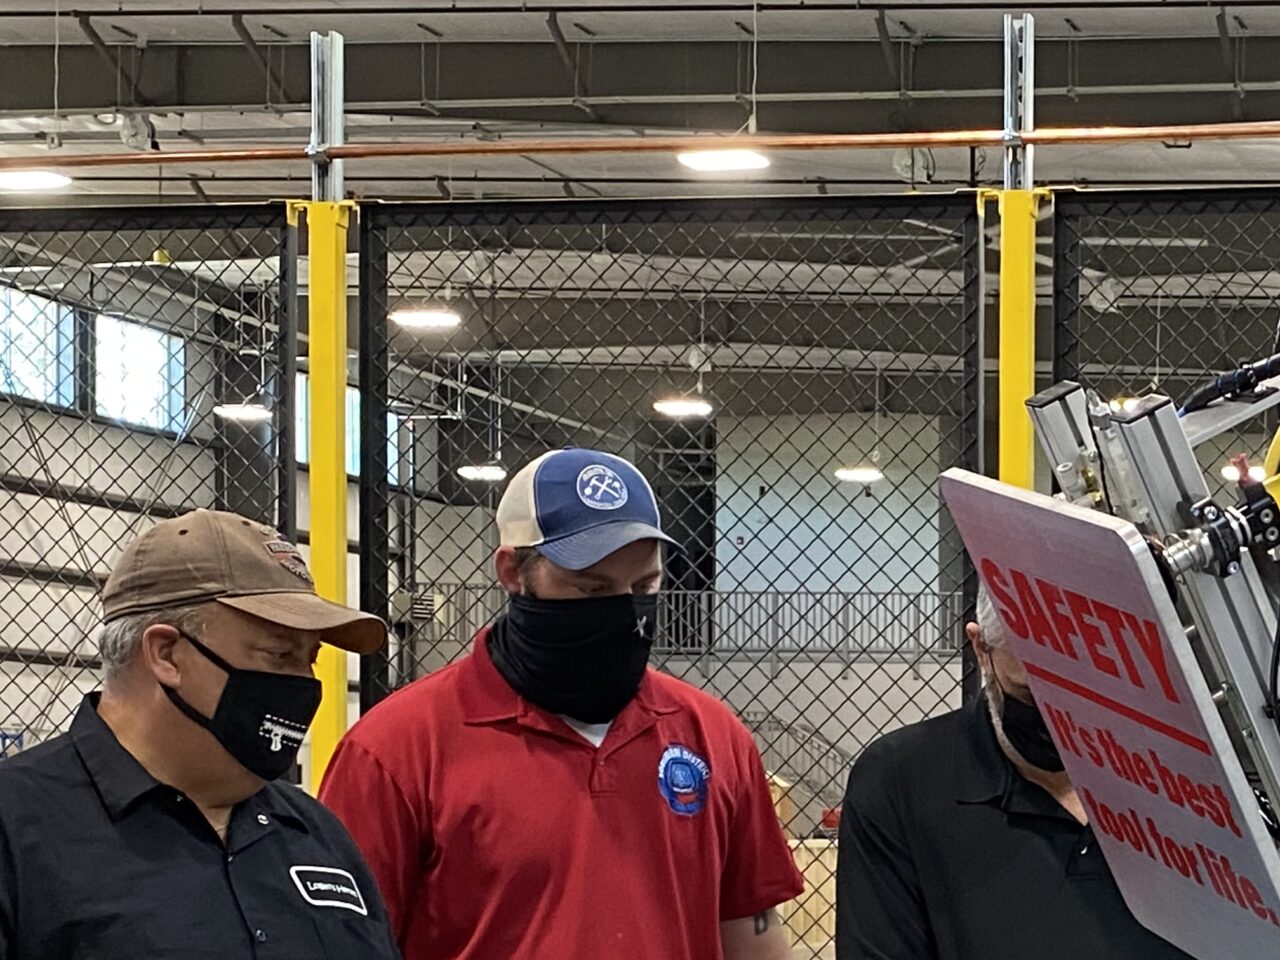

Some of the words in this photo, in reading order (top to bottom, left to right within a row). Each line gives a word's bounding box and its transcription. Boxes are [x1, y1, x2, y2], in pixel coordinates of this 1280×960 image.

[980, 557, 1181, 704] SAFETY
[1043, 702, 1104, 768] It's
[1095, 728, 1160, 795] the
[1148, 749, 1243, 838] best
[1083, 786, 1156, 860] tool
[1146, 817, 1204, 886] for
[1195, 842, 1280, 928] life.
